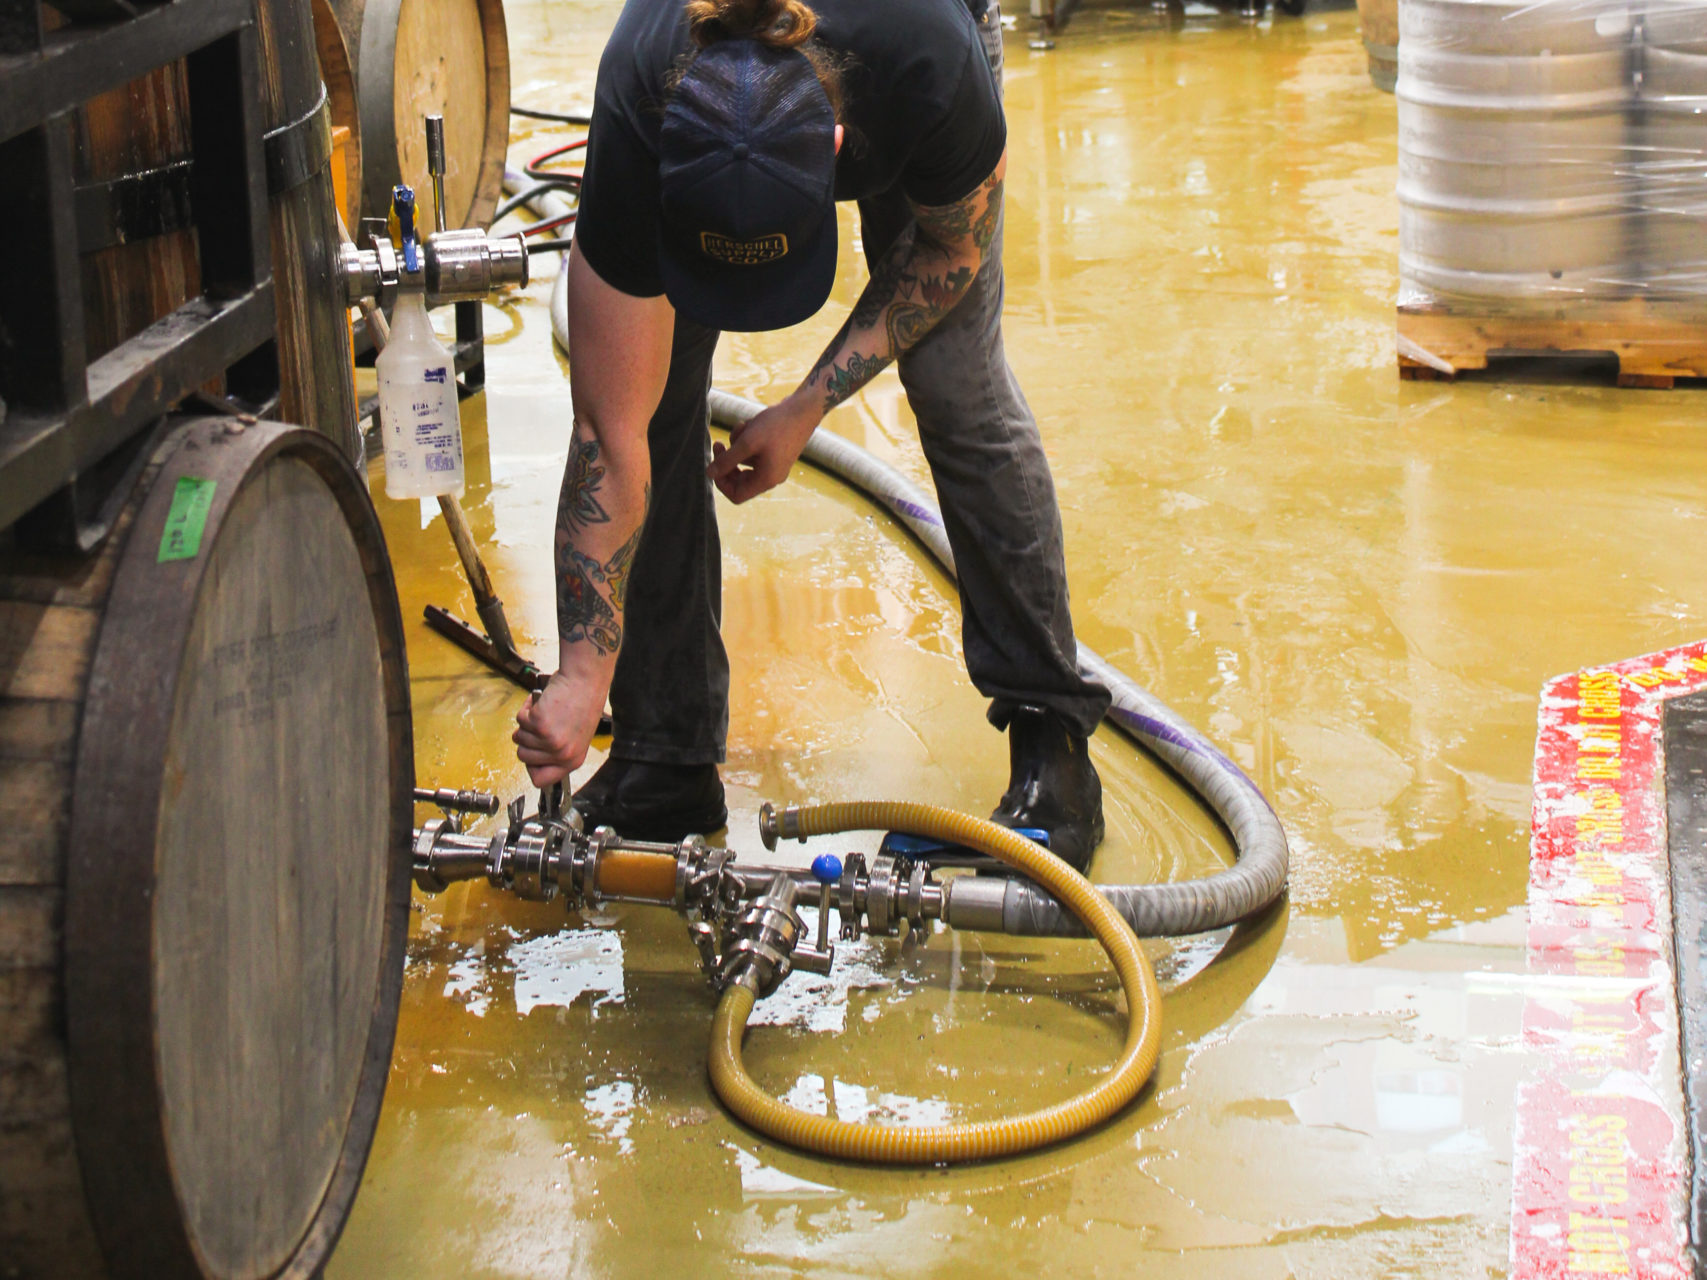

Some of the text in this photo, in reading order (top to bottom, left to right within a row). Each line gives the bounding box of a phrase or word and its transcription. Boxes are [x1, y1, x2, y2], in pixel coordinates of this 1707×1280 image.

[1578, 672, 1621, 718] CROSS
[1577, 757, 1621, 779] DO
[1568, 1113, 1629, 1204] CROSS
